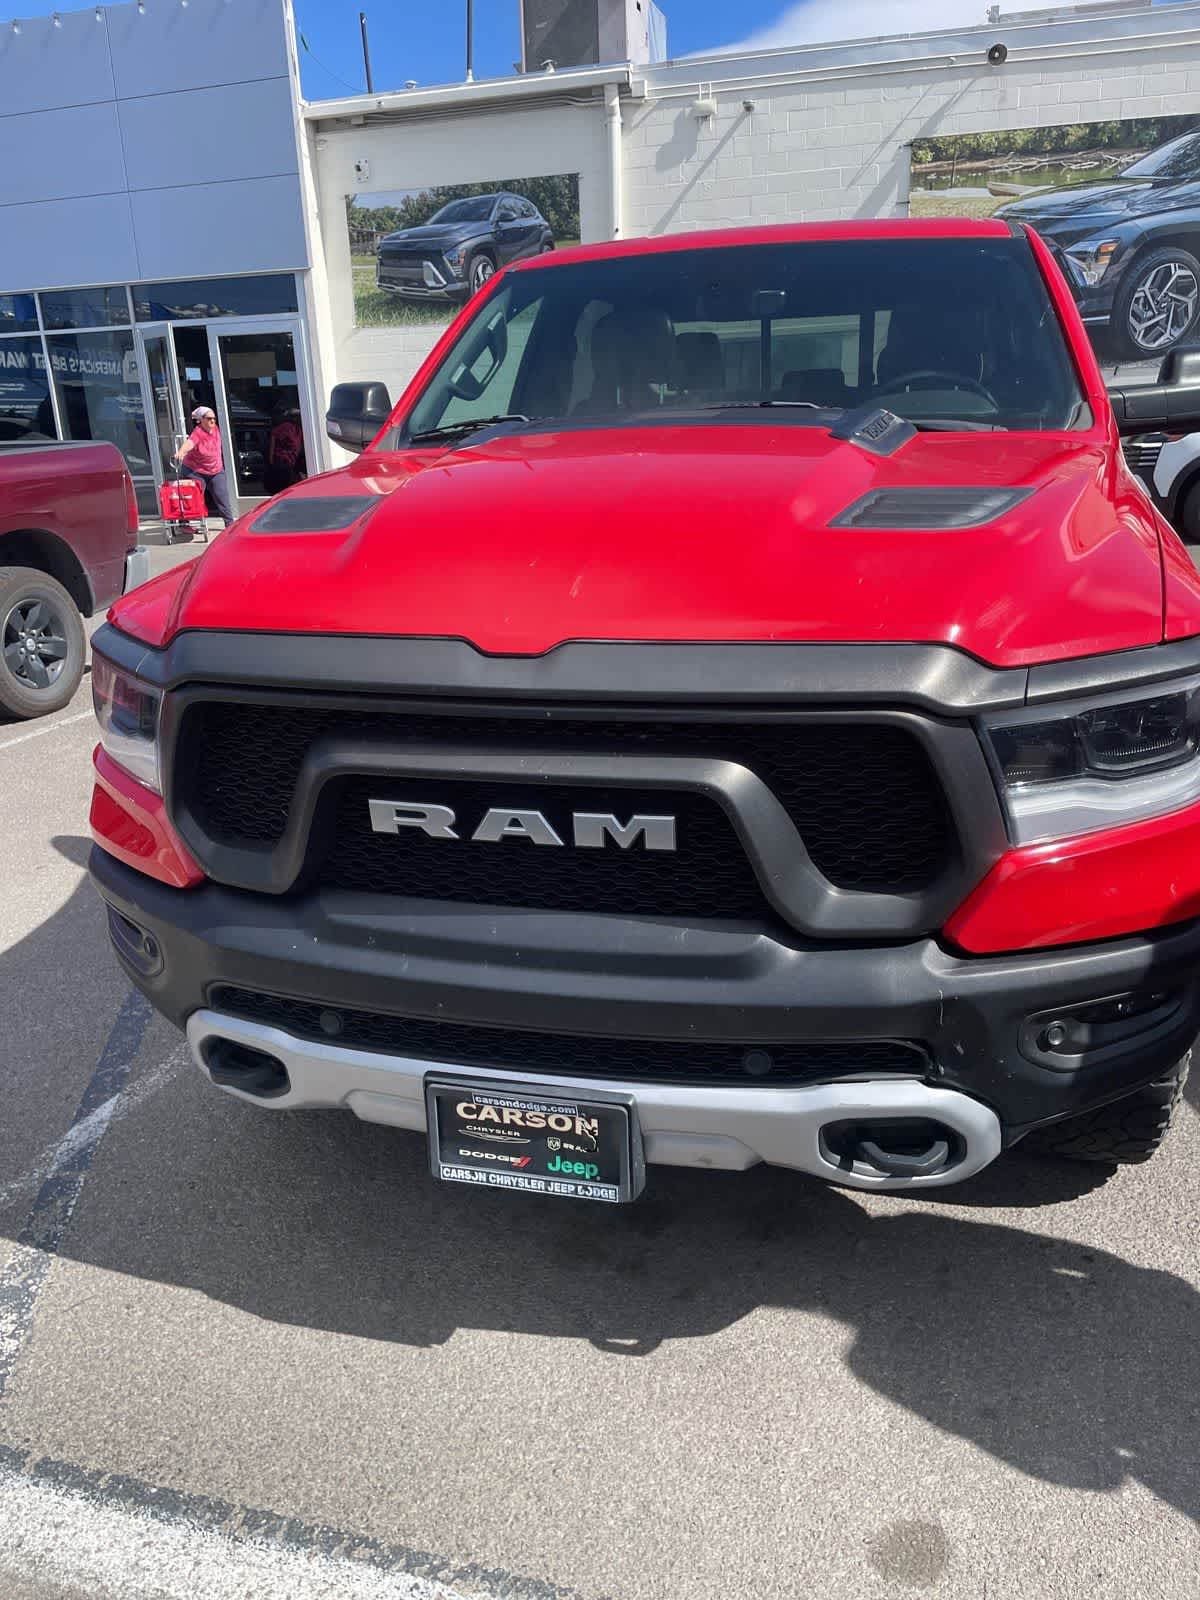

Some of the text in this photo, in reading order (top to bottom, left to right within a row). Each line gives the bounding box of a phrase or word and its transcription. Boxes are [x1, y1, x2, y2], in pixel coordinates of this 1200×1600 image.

[368, 799, 676, 850] RAM
[475, 1095, 576, 1114] carsondodge.com
[456, 1102, 599, 1136] CARSON
[466, 1125, 520, 1137] CHRYSLER
[459, 1149, 521, 1164] DODGE
[547, 1155, 598, 1179] Jeep
[489, 1173, 545, 1191] CHRYSLER
[548, 1182, 575, 1193] JEEP
